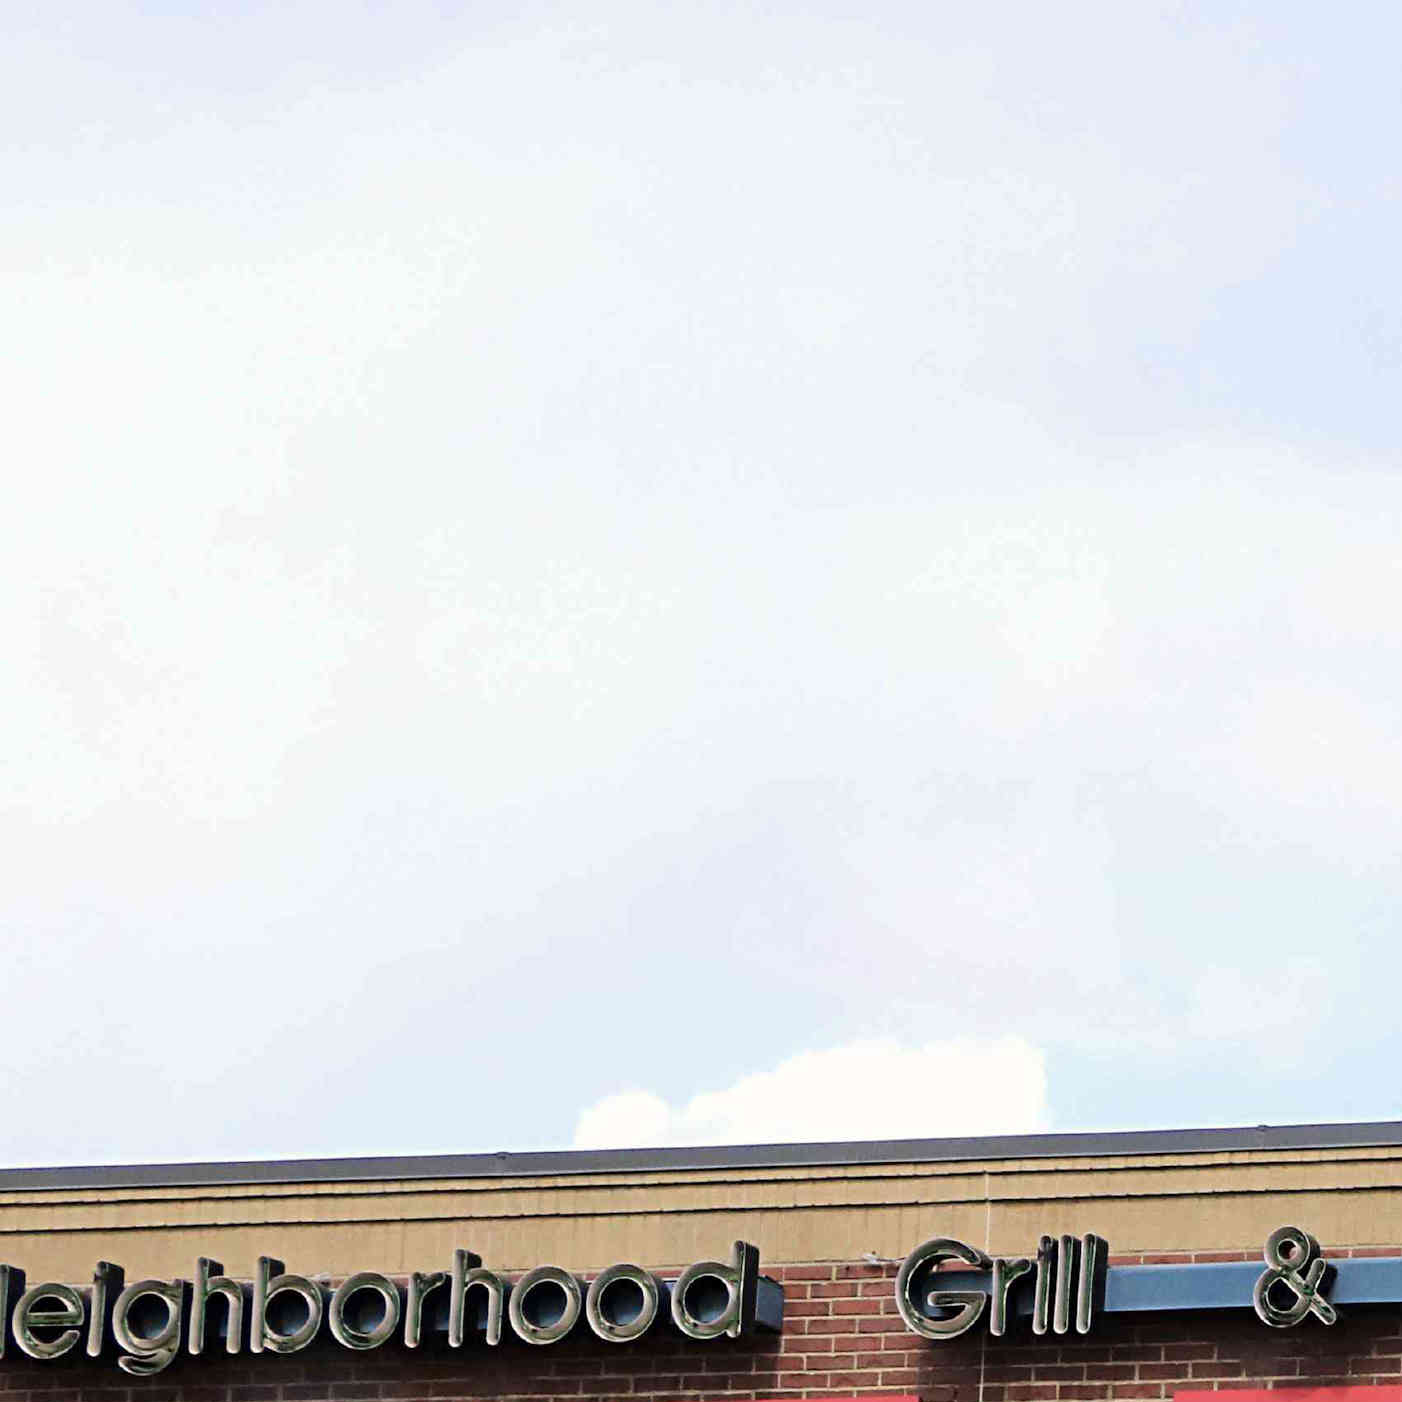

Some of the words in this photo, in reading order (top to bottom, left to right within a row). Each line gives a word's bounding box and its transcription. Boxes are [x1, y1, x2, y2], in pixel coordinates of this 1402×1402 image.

[0, 1241, 760, 1376] eighborhood
[896, 1233, 1109, 1339] Grill
[1254, 1224, 1337, 1327] &
